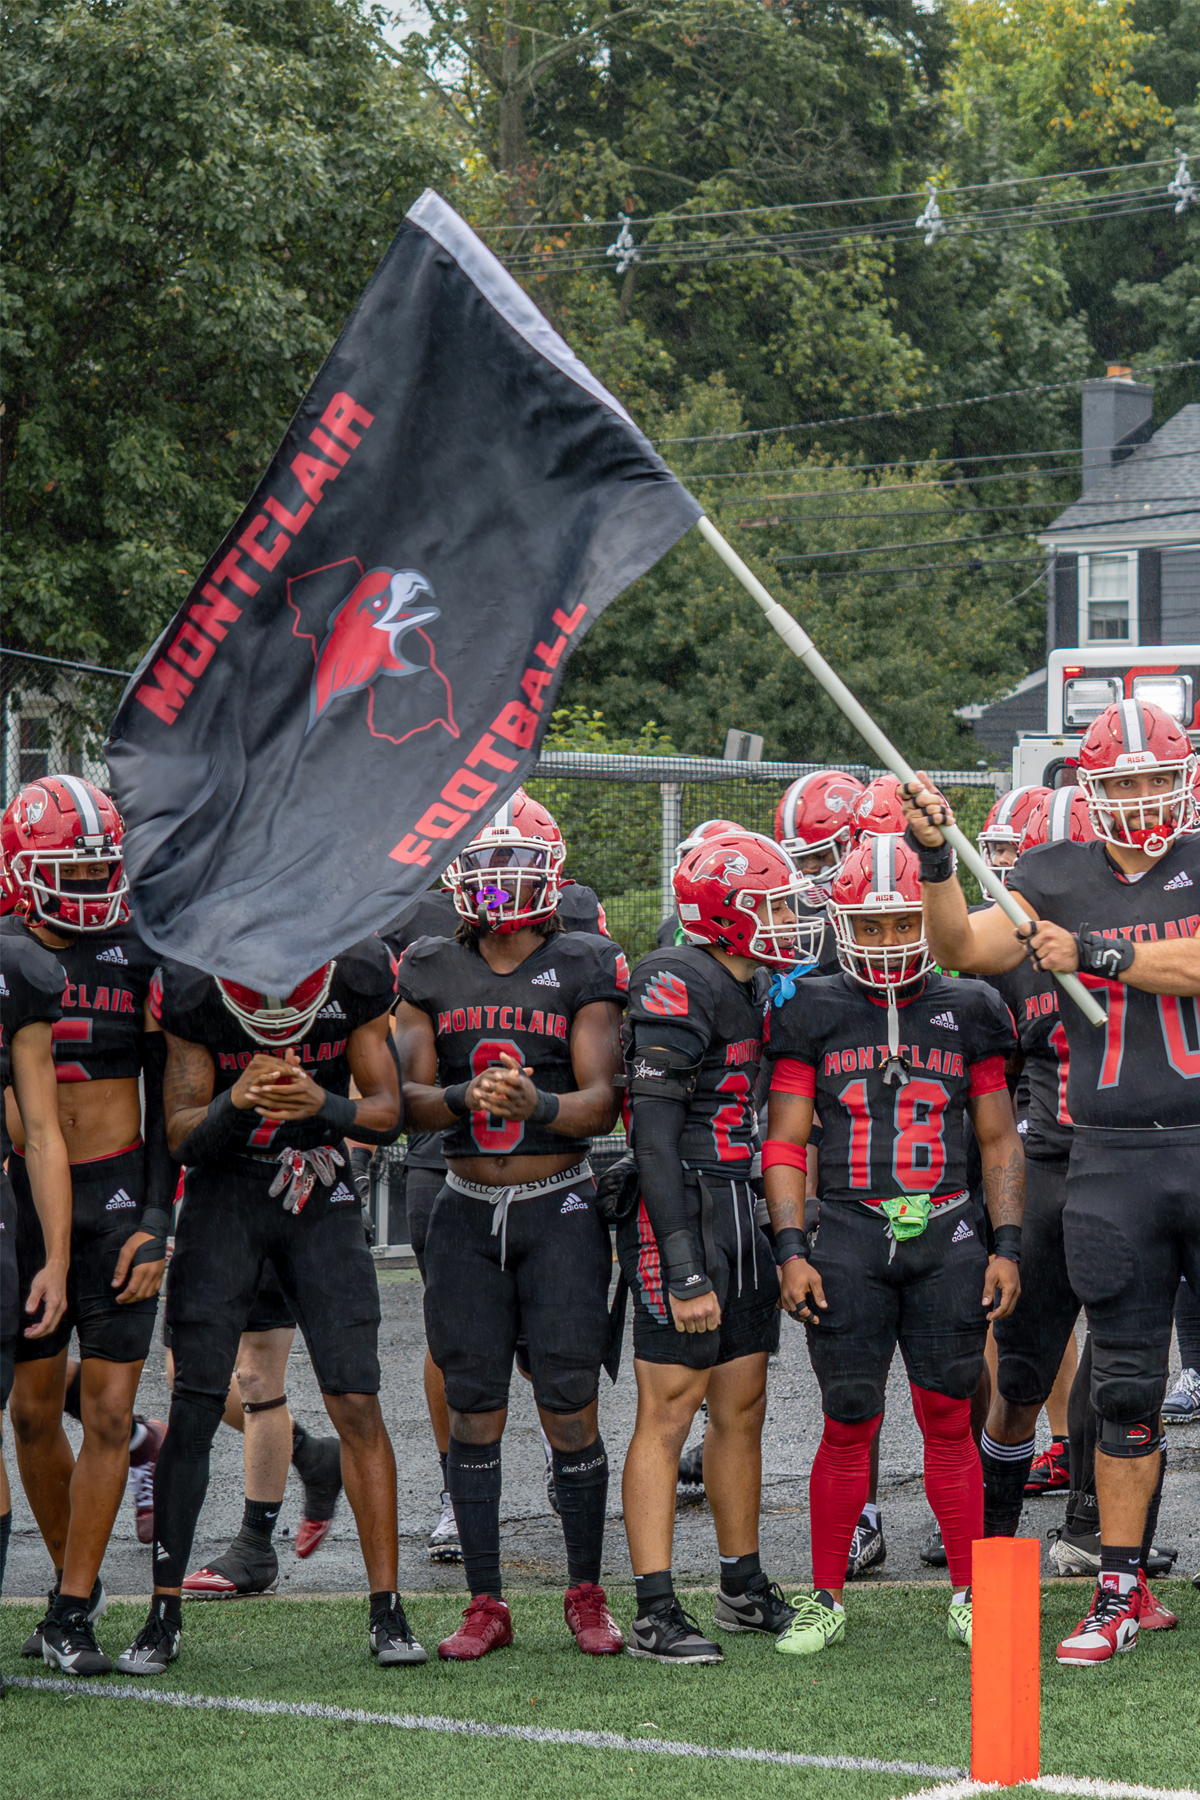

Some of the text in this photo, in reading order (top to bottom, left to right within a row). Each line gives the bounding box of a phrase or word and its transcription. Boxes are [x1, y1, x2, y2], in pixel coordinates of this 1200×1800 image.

[135, 391, 376, 727] MONTCLAIR
[388, 602, 588, 868] FOOTBALL
[1127, 755, 1146, 763] RISE
[1163, 878, 1194, 891] adidas
[875, 894, 894, 902] RISE
[96, 953, 129, 966] adidas
[531, 977, 561, 988] adidas
[63, 983, 136, 1013] CLAIR
[316, 1011, 347, 1020] adidas
[437, 1005, 567, 1040] MONTCLAIR
[929, 1015, 959, 1031] adidas
[837, 1076, 951, 1193] 18
[525, 1164, 581, 1192] ADIDAS
[330, 1193, 355, 1203] adidas
[105, 1199, 137, 1211] adidas
[560, 1201, 589, 1214] adidas
[951, 1228, 975, 1244] adidas
